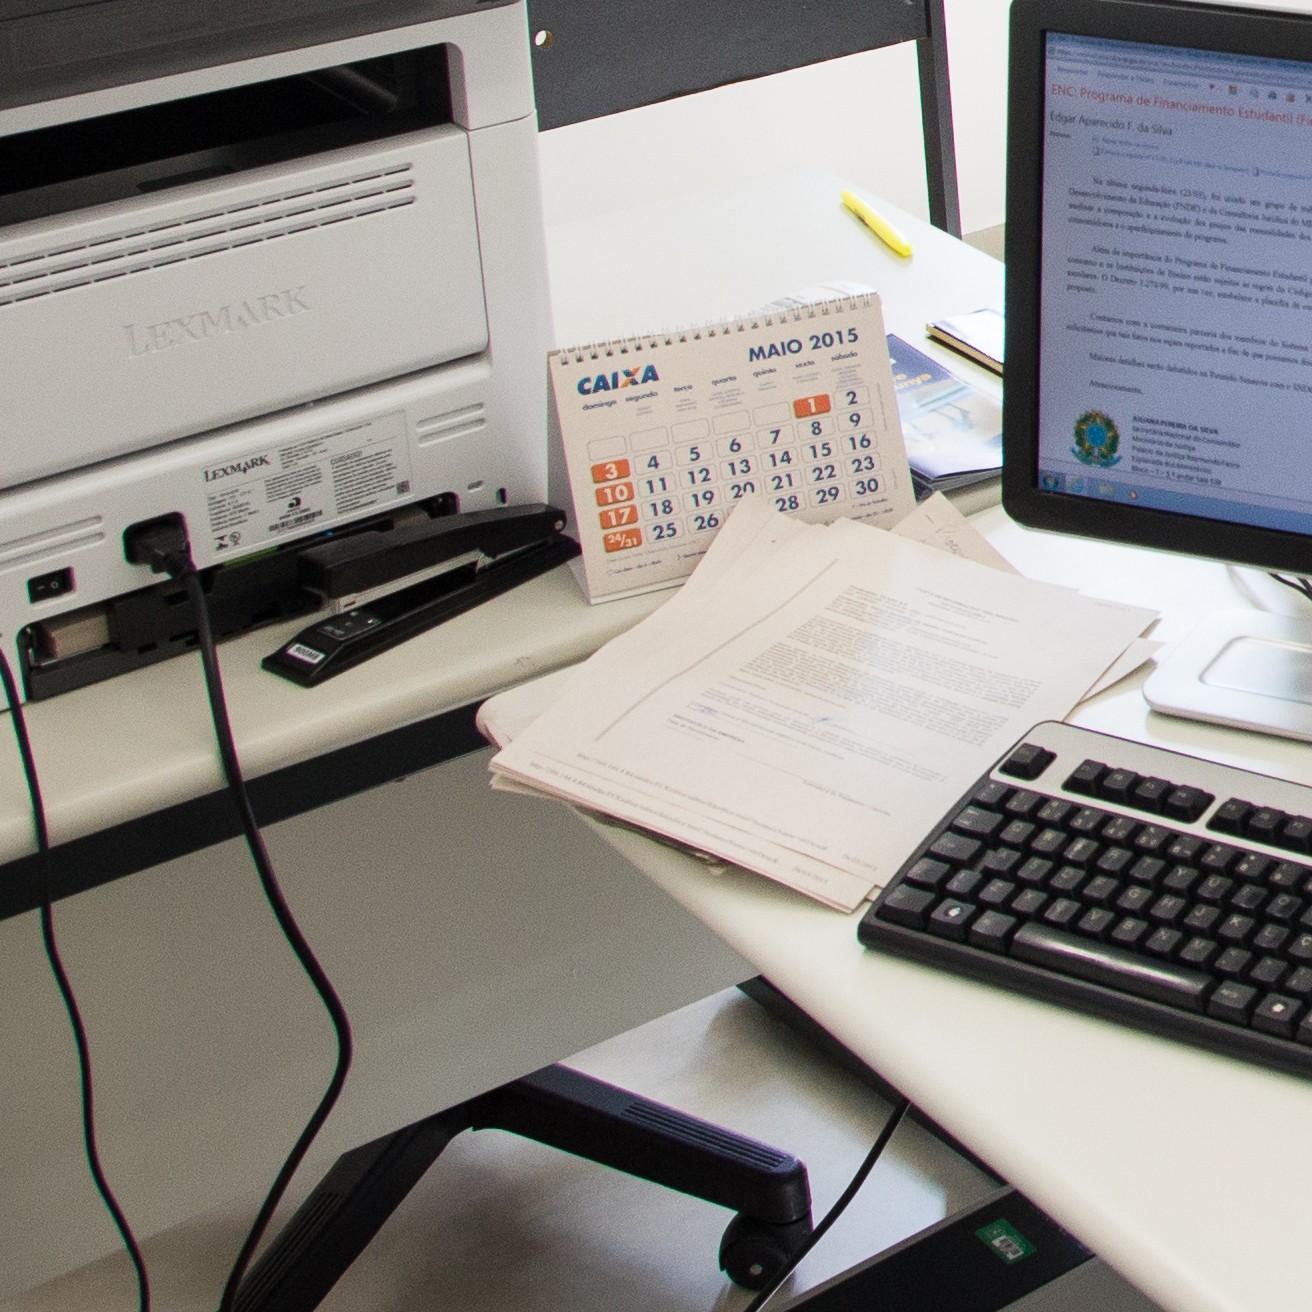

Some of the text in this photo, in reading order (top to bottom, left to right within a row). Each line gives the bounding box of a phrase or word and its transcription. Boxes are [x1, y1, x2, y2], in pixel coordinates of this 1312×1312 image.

[122, 285, 312, 359] LEXMARK
[577, 327, 859, 395] CAIXA MAIO 2015
[808, 391, 858, 413] 1 2
[204, 454, 271, 483] LEXMARK
[603, 433, 871, 504] 10 11 12 13 14 15 16
[605, 412, 861, 480] 3 4 5 6 7 8 9
[607, 478, 879, 547] 24/31 25 26 28 29 30
[608, 508, 631, 526] 17
[650, 499, 673, 517] 18
[691, 490, 714, 507] 19
[771, 473, 793, 490] 21
[812, 464, 836, 482] 22
[851, 455, 875, 473] 23
